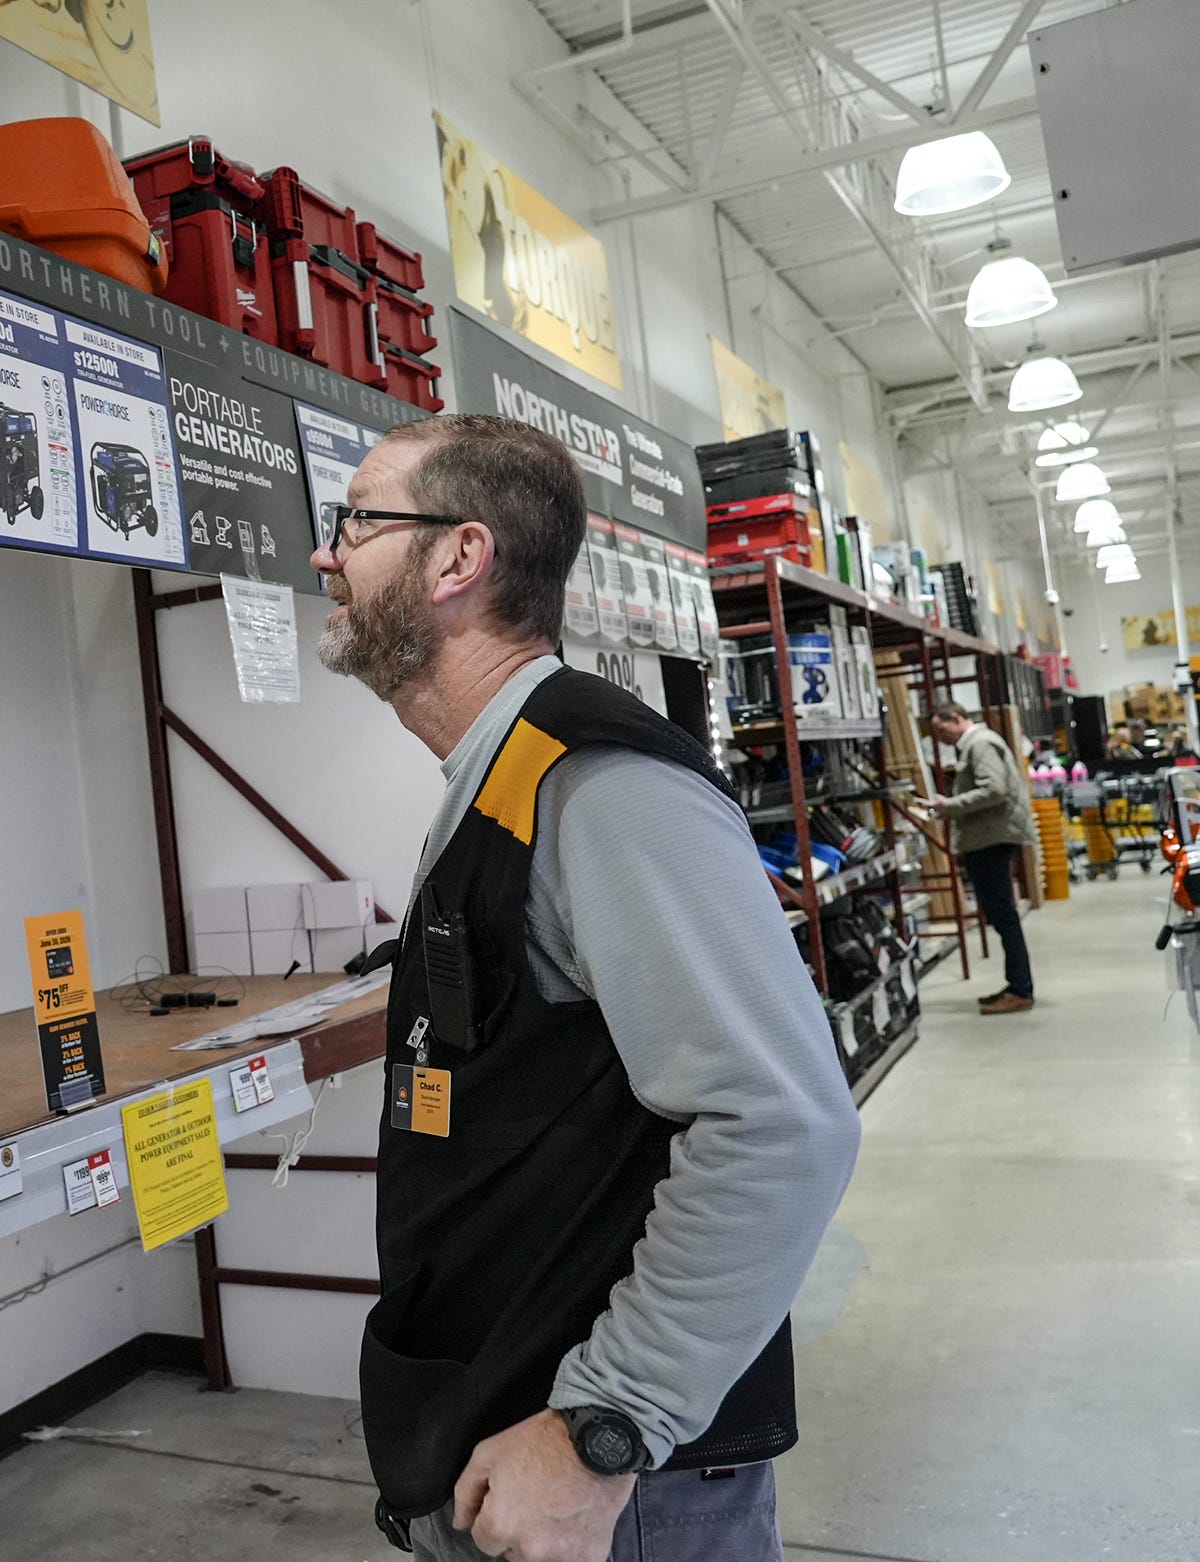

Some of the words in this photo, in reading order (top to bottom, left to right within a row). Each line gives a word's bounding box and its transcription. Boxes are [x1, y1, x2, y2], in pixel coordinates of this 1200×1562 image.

[6, 303, 14, 315] IN
[16, 309, 39, 325] STORE
[83, 332, 116, 352] AVAILABLE
[117, 344, 124, 355] IN
[125, 348, 144, 362] STORE
[145, 300, 206, 348] TOOL
[219, 335, 230, 353] +
[242, 341, 351, 405] EQUIPMENT
[74, 351, 119, 378] s12500t
[170, 378, 264, 435] PORTABLE
[175, 412, 297, 474] GENERATORS
[180, 453, 212, 472] Versatile
[214, 464, 227, 476] and
[229, 468, 244, 480] cost
[245, 472, 272, 489] effective
[182, 470, 213, 485] portable
[215, 478, 239, 491] power.
[420, 1081, 435, 1092] Chad
